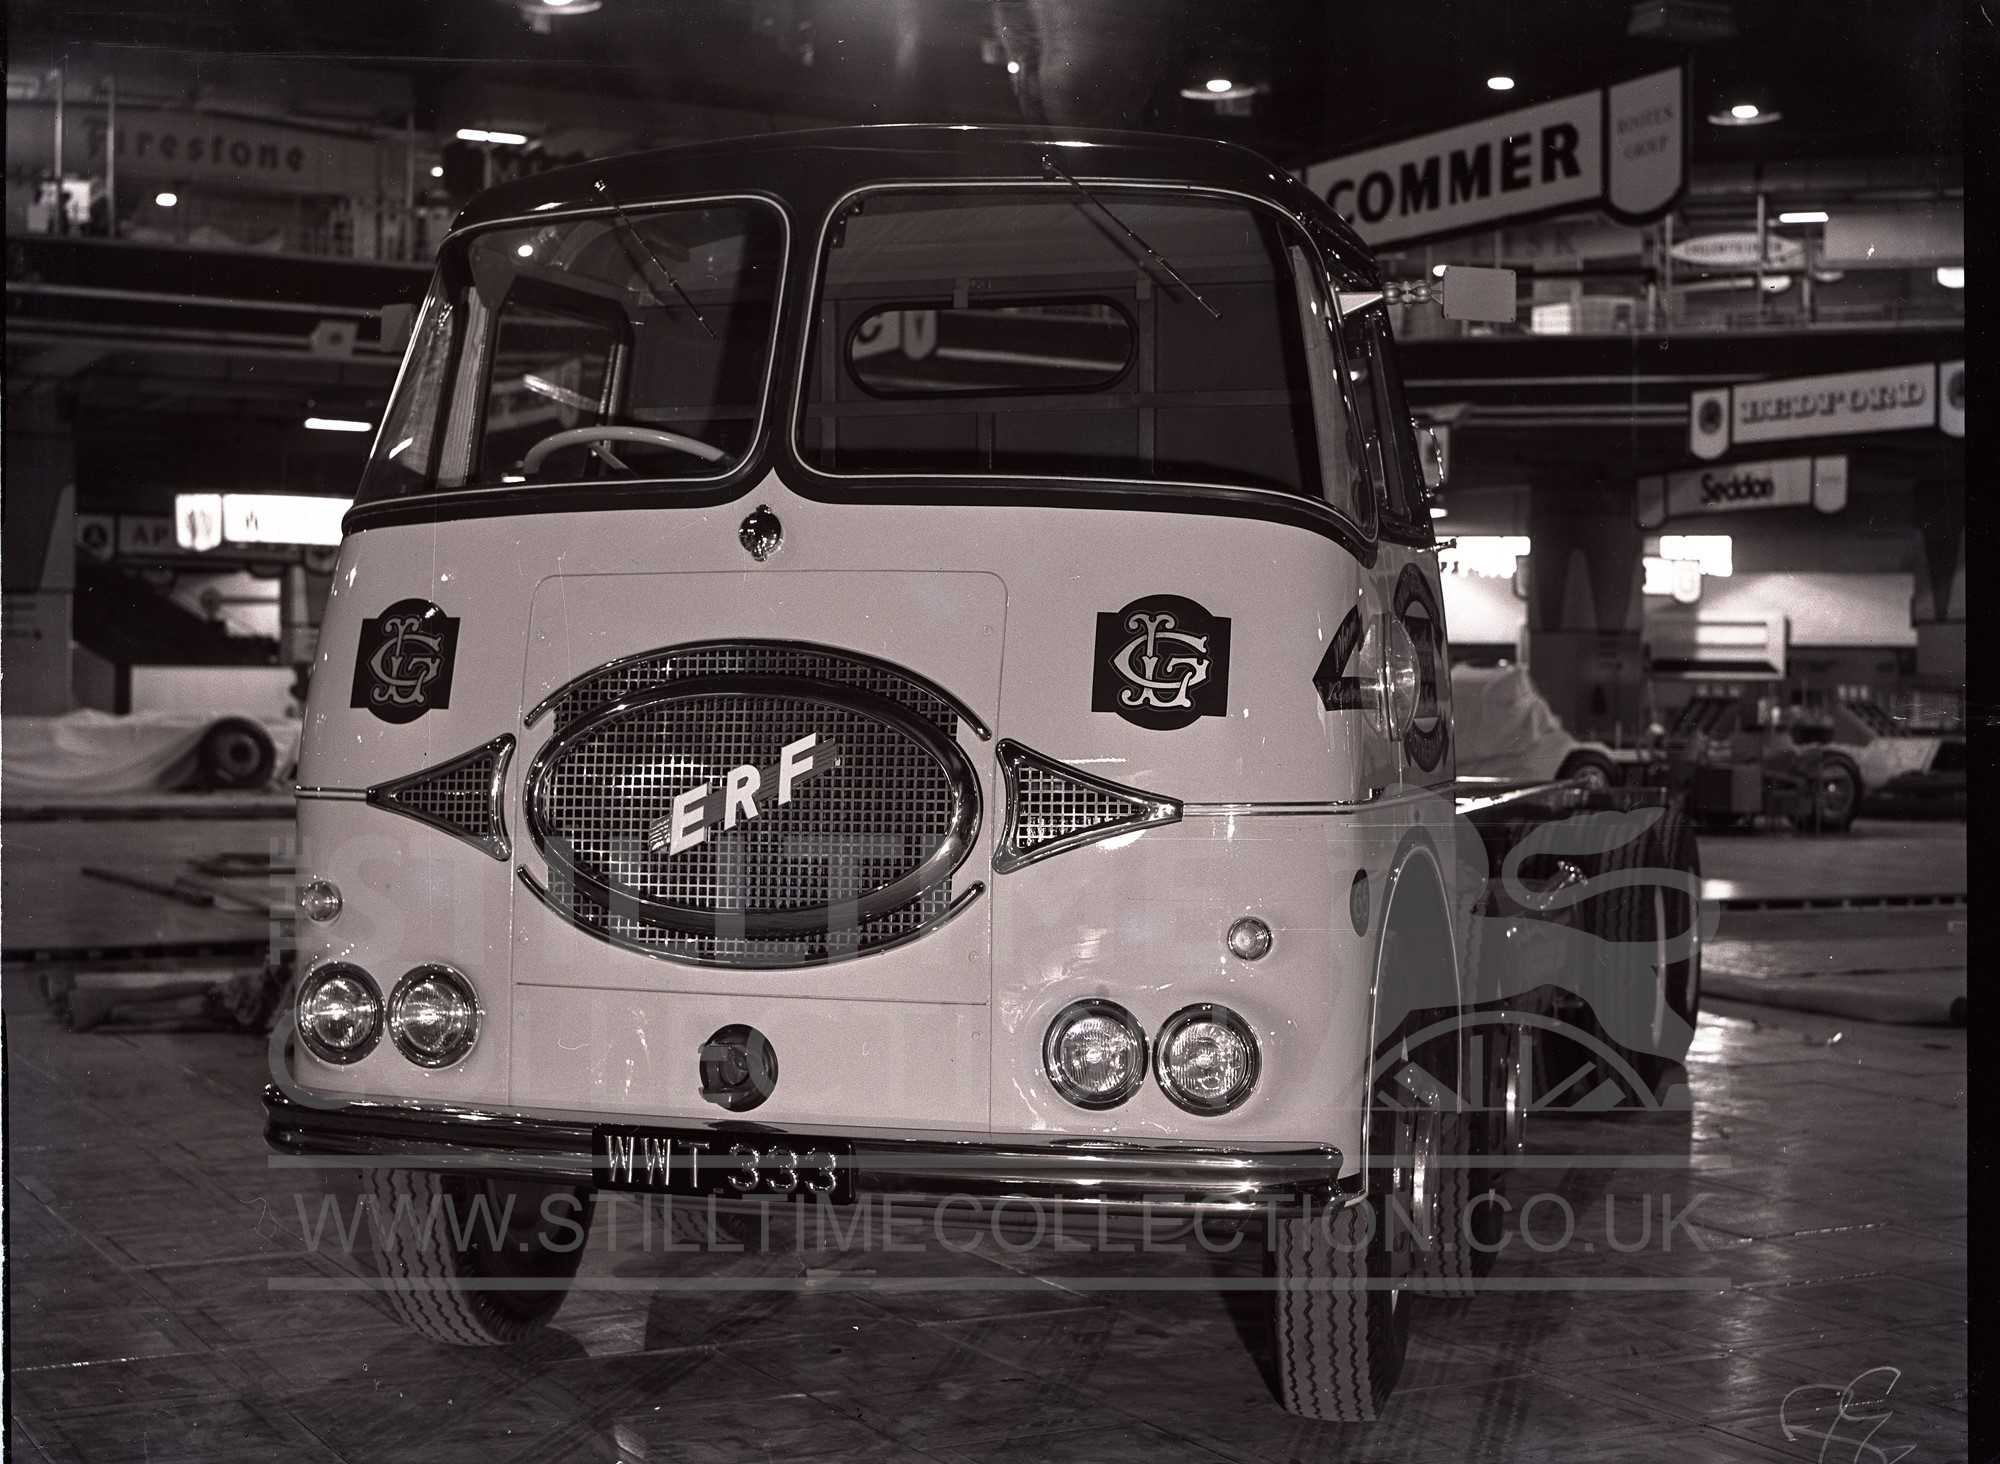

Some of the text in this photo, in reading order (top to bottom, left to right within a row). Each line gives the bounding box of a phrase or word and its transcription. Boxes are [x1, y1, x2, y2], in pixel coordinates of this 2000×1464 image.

[1326, 122, 1581, 226] COMMER
[1741, 383, 1927, 424] BEDFORD
[1700, 473, 1775, 504] Seddon
[669, 732, 817, 857] ERF
[604, 1135, 838, 1193] WWT 333
